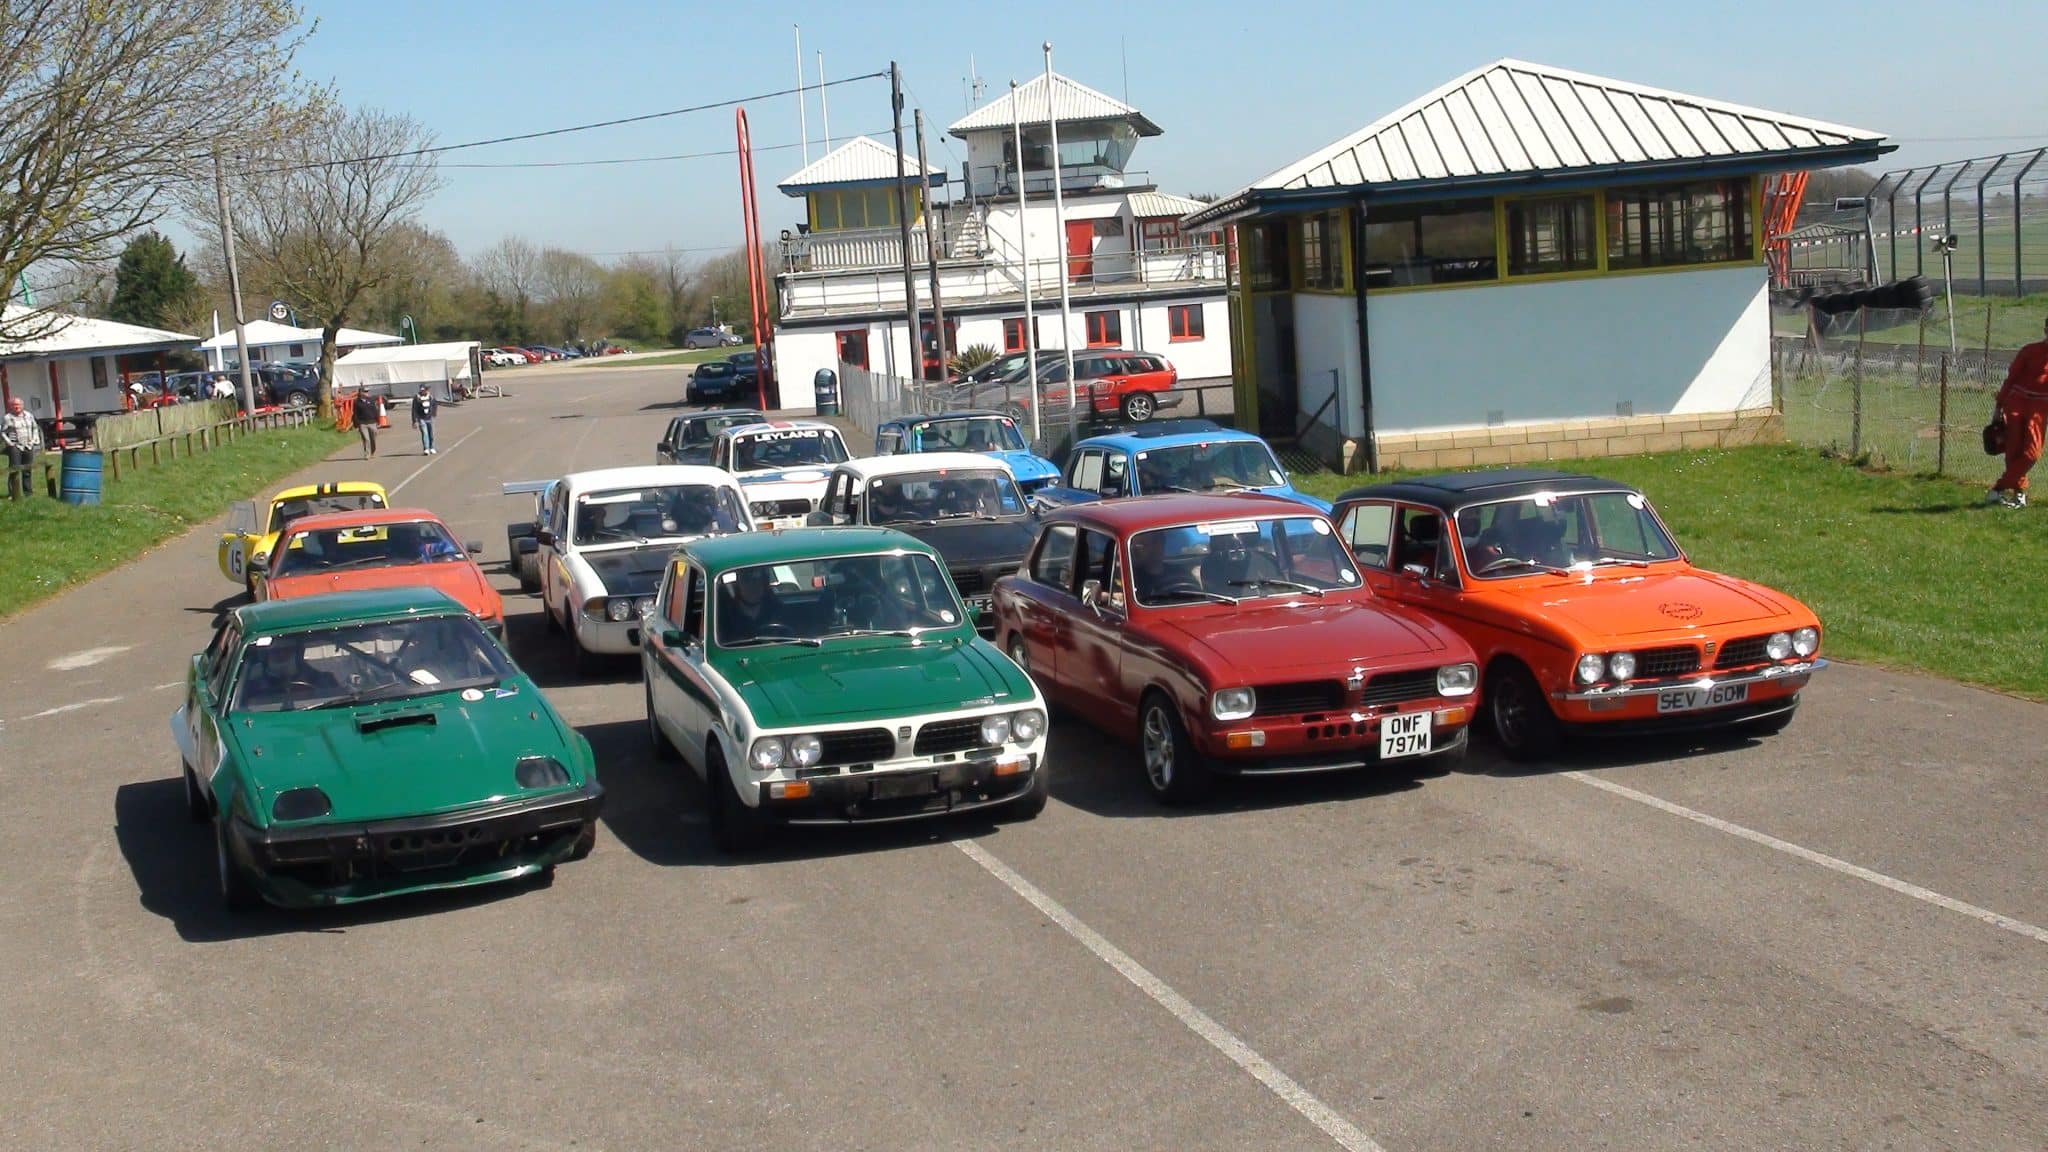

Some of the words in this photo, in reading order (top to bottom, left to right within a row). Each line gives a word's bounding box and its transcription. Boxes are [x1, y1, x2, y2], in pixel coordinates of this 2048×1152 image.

[753, 430, 819, 442] LEYLAND
[231, 549, 242, 575] 15
[1660, 691, 1697, 710] SEV
[1391, 714, 1423, 735] OWF
[1385, 732, 1427, 755] 797M
